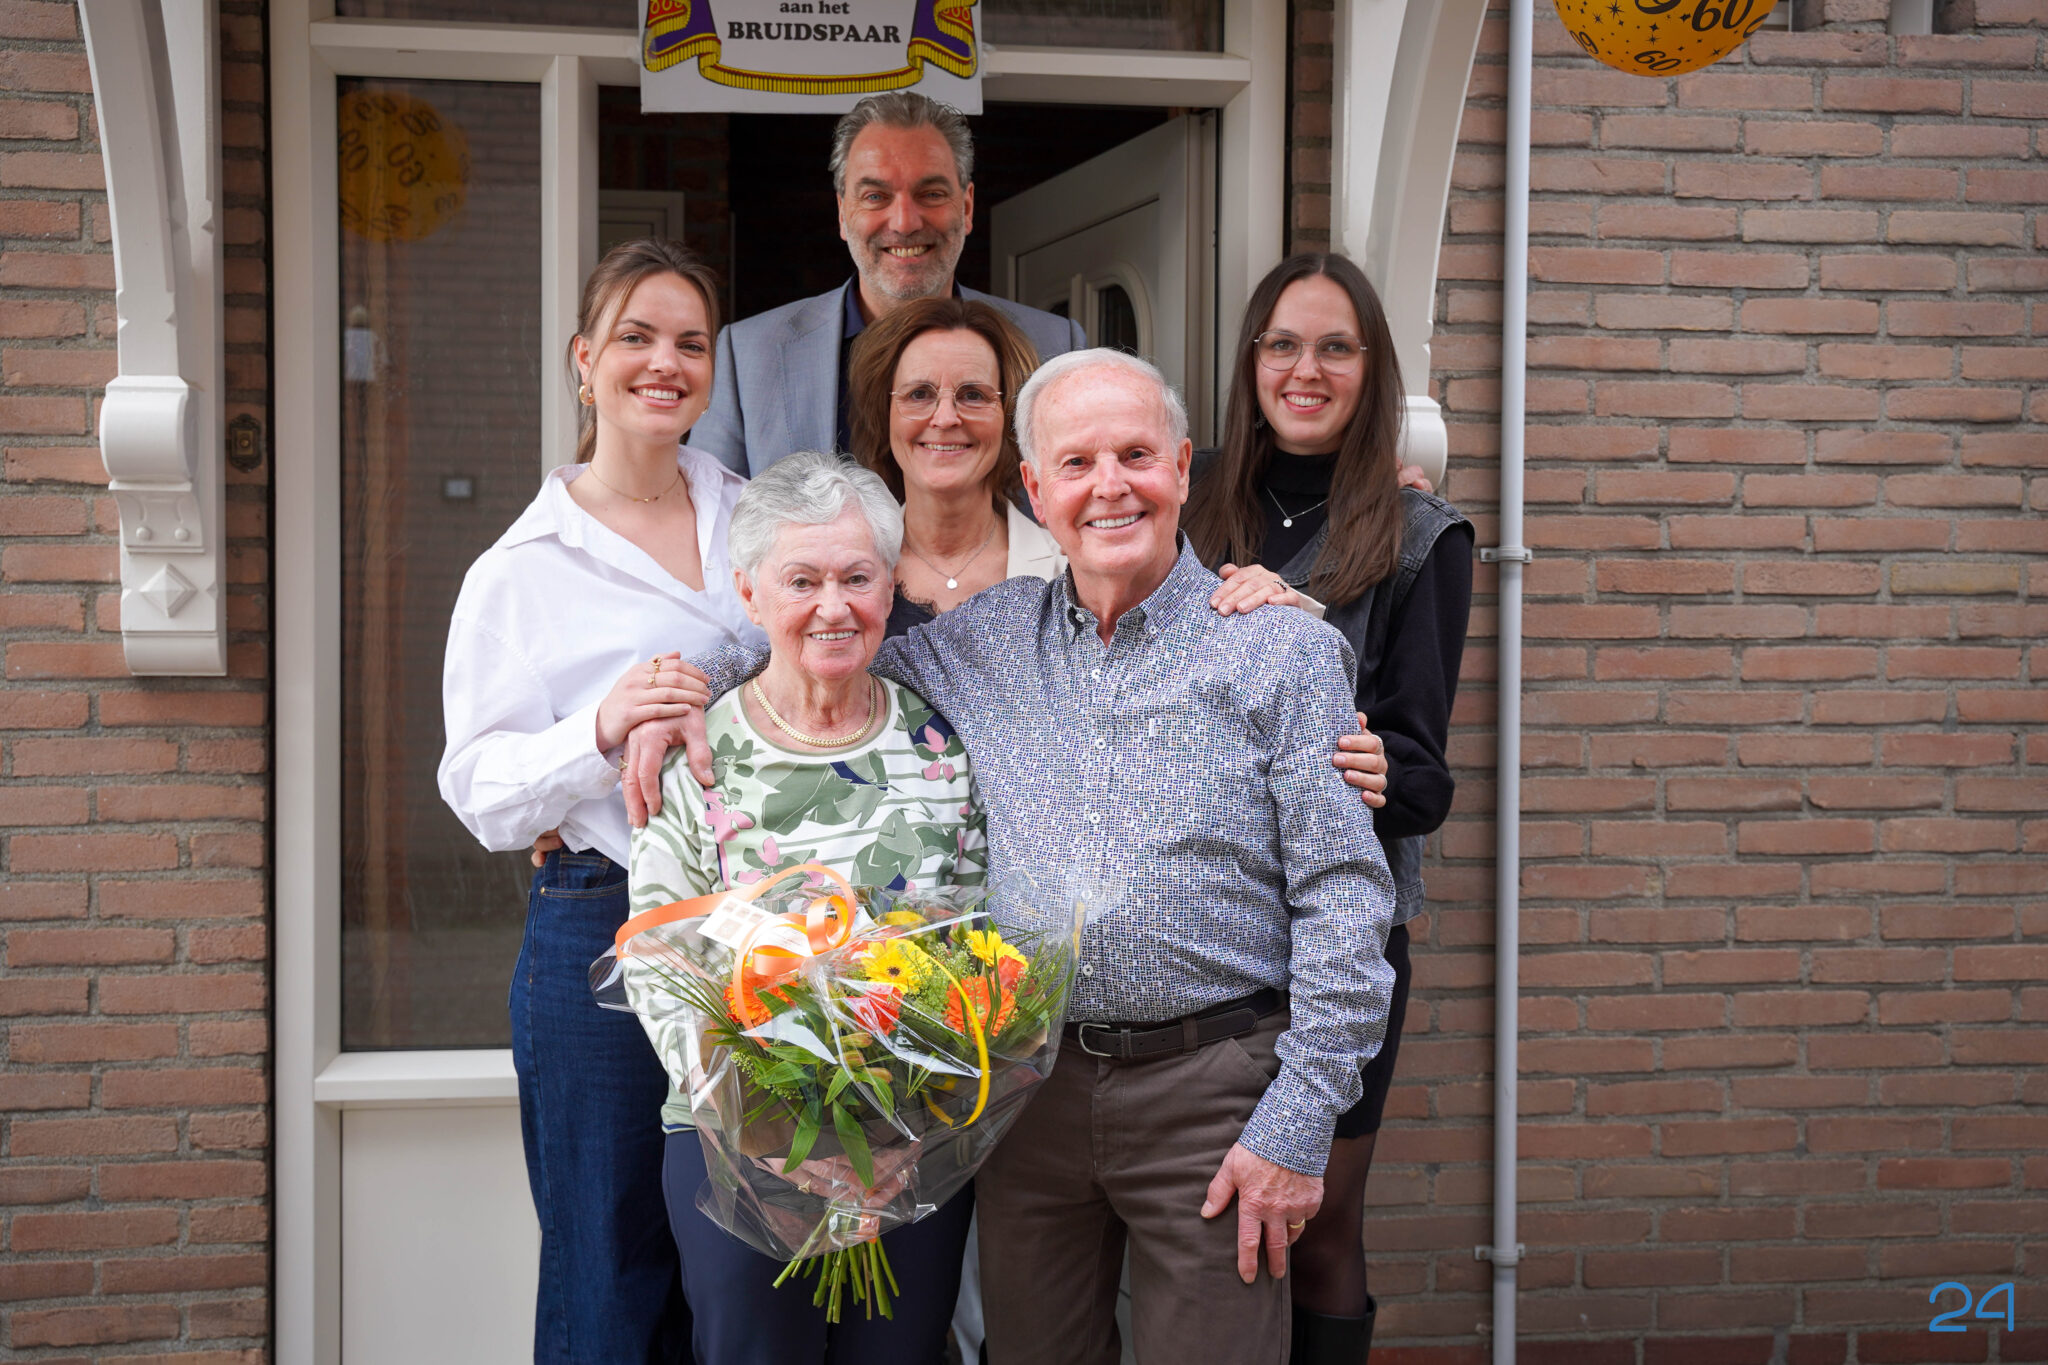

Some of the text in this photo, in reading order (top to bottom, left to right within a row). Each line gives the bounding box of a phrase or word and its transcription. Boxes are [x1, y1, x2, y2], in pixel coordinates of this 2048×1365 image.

[779, 0, 850, 14] aan het
[727, 21, 902, 43] BRUIDSPAAR
[1633, 50, 1682, 71] 60
